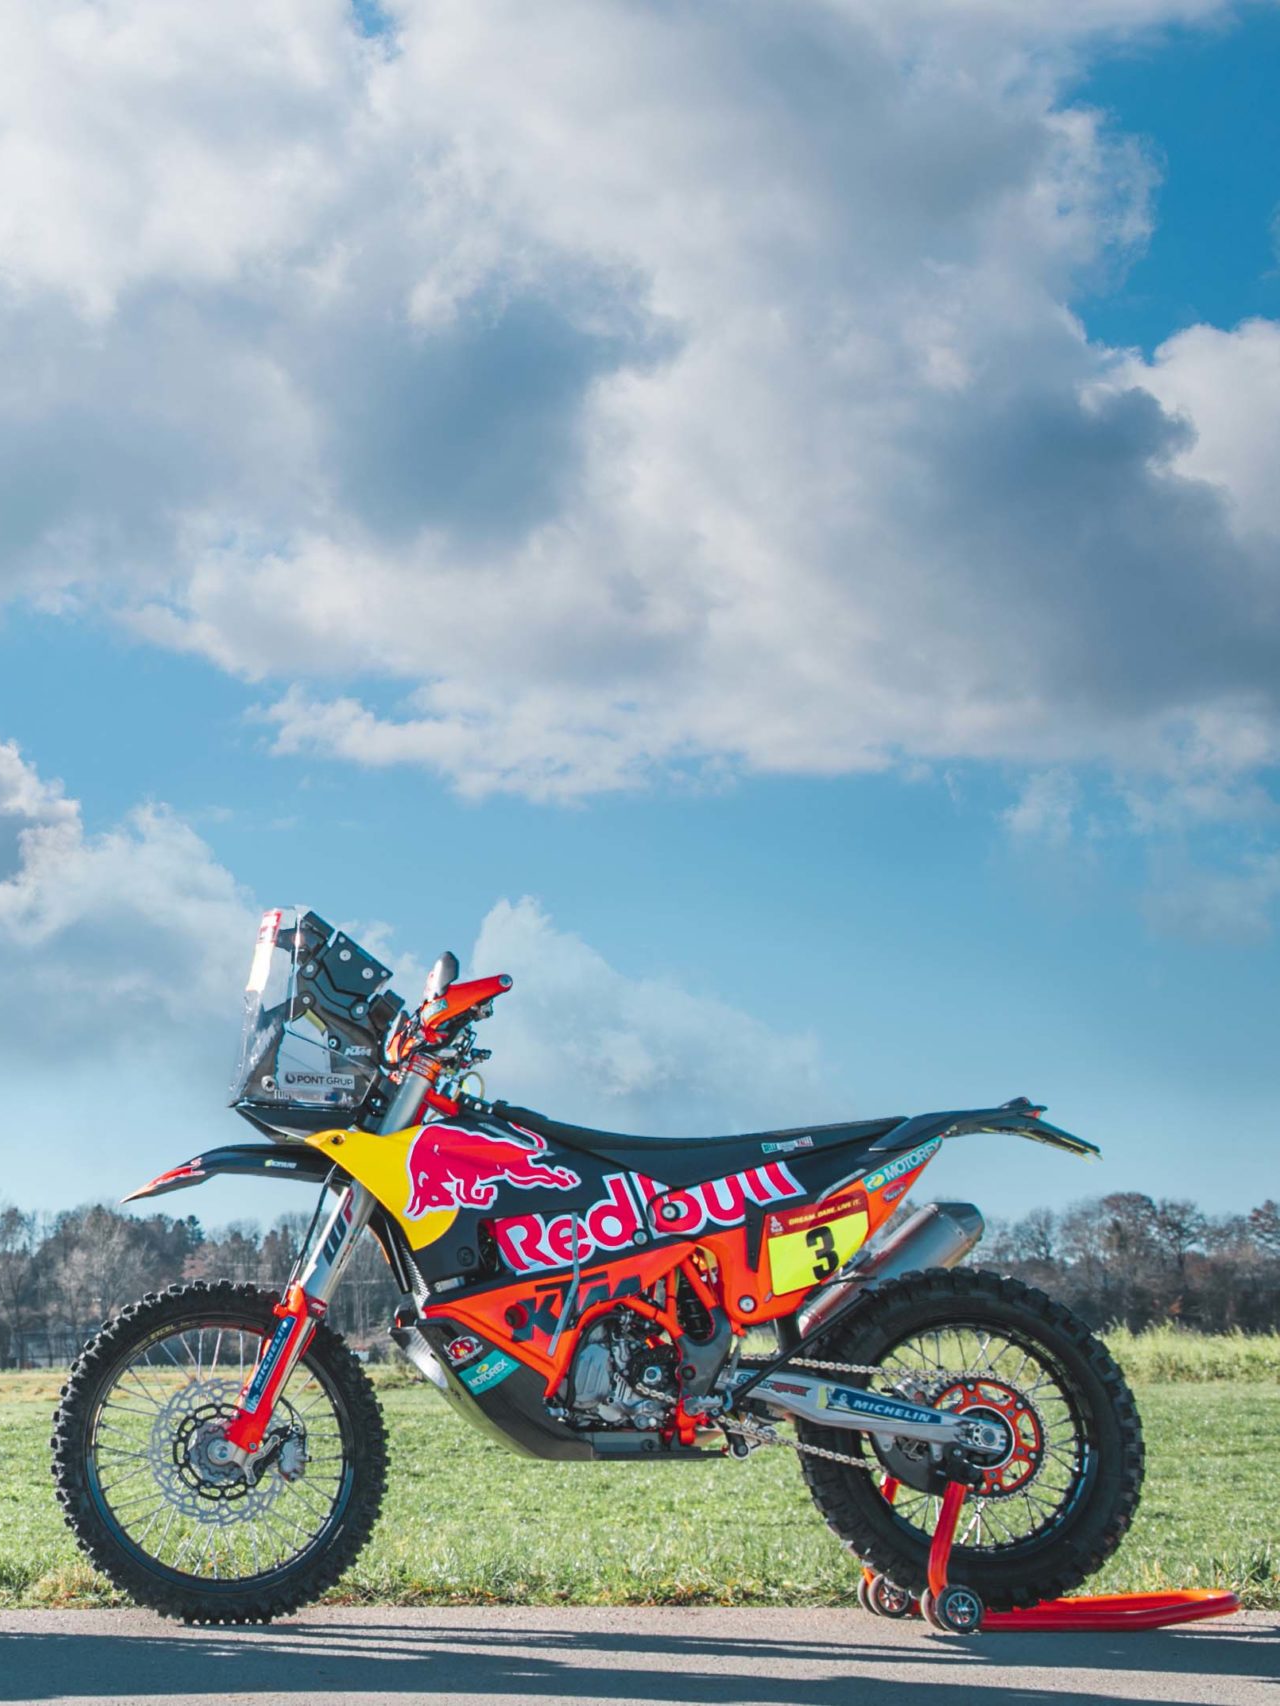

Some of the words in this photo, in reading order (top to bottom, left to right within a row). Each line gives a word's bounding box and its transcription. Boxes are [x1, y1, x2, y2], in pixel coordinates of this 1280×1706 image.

[297, 1075, 325, 1085] PONT
[326, 1076, 353, 1086] GRUP
[806, 1226, 839, 1280] 3
[468, 1358, 508, 1388] MOTOREX
[852, 1400, 931, 1423] MICHELIN
